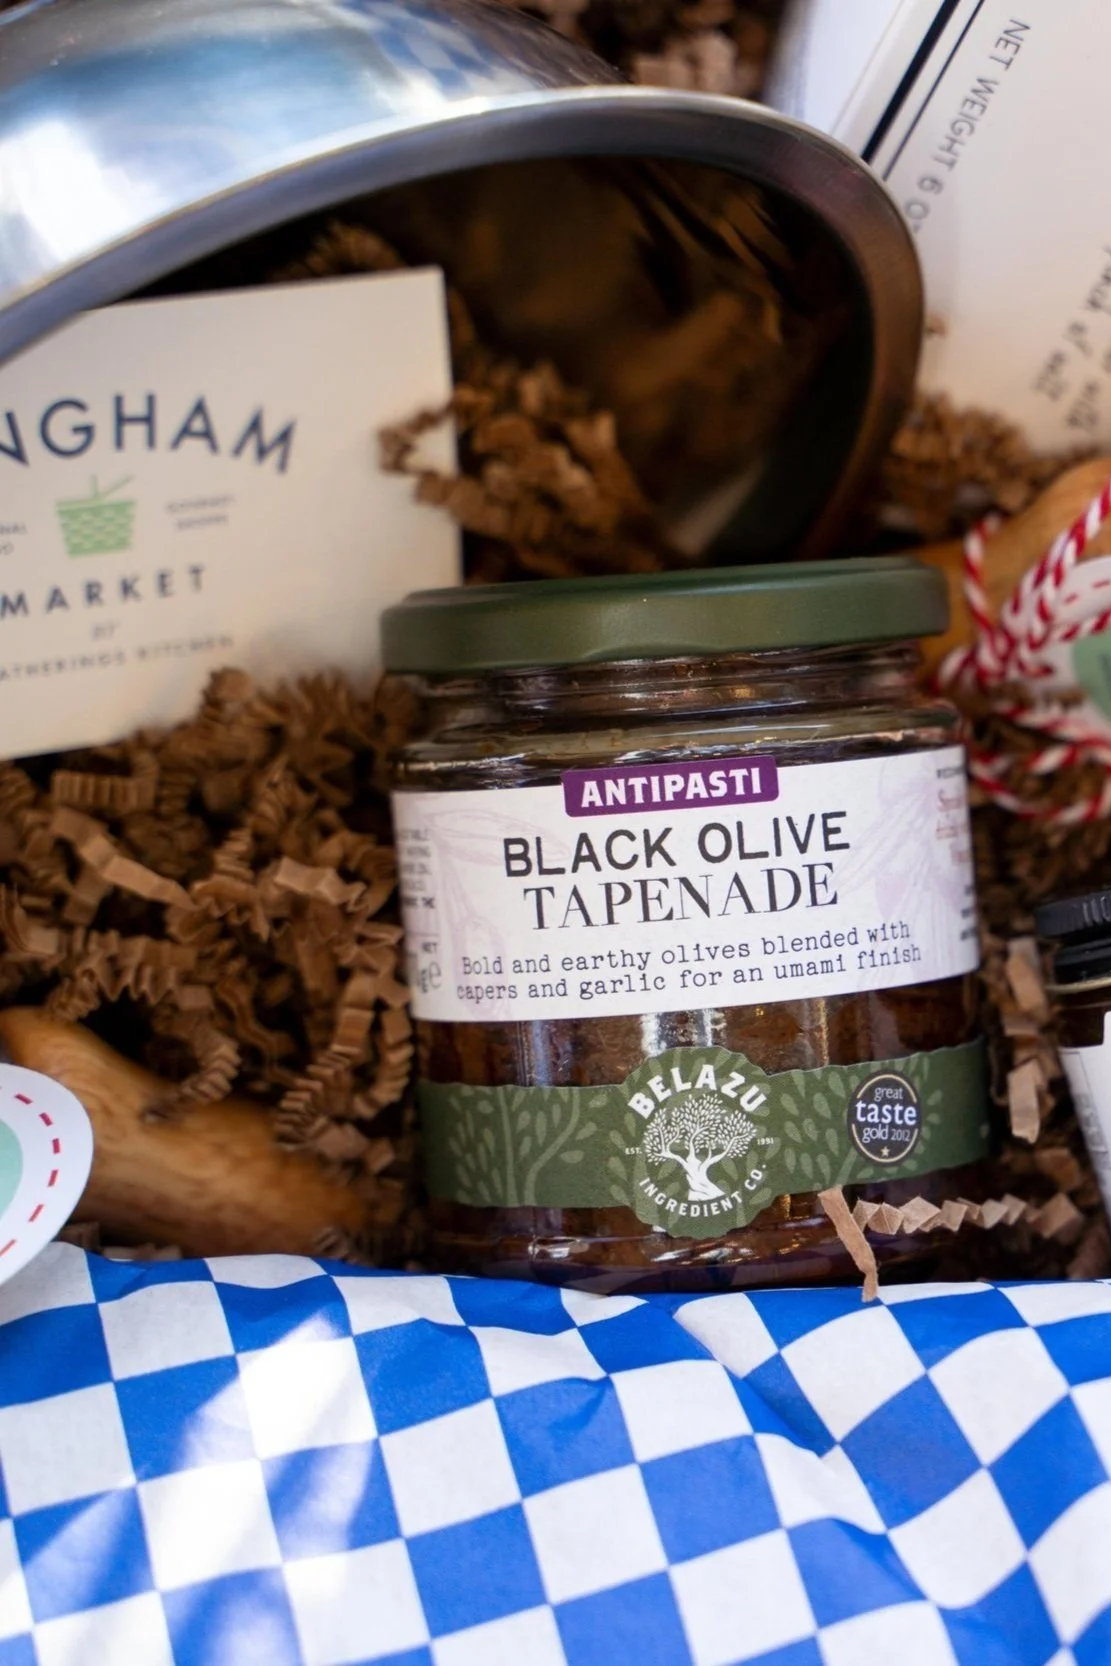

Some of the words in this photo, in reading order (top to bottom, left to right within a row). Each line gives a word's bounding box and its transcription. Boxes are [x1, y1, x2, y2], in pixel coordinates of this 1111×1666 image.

[989, 17, 1032, 71] NET
[933, 76, 1000, 173] WEIGHT
[917, 174, 944, 196] 6
[904, 198, 931, 233] O
[0, 563, 205, 619] MARKET
[579, 766, 764, 809] ANTIPASTI
[503, 826, 677, 878] BLACK
[697, 811, 851, 865] OLIVE
[523, 862, 839, 931] TAPENADE
[456, 981, 519, 1004] capers
[527, 979, 569, 999] and
[579, 973, 666, 1000] garlic
[679, 967, 723, 988] for
[732, 965, 764, 983] an
[774, 956, 847, 980] umami
[856, 944, 922, 970] finish
[462, 955, 503, 977] Bold
[512, 953, 552, 974] and
[560, 948, 651, 978] earthy
[660, 941, 751, 967] olives
[761, 928, 860, 957] blended
[866, 920, 912, 945] with
[627, 1063, 768, 1120] BELAZU
[855, 1100, 918, 1126] taste
[874, 1085, 904, 1102] great
[861, 1125, 889, 1144] gold
[890, 1128, 911, 1143] 2012
[639, 1176, 744, 1218] INGREDIENT
[744, 1163, 768, 1191] CO.
